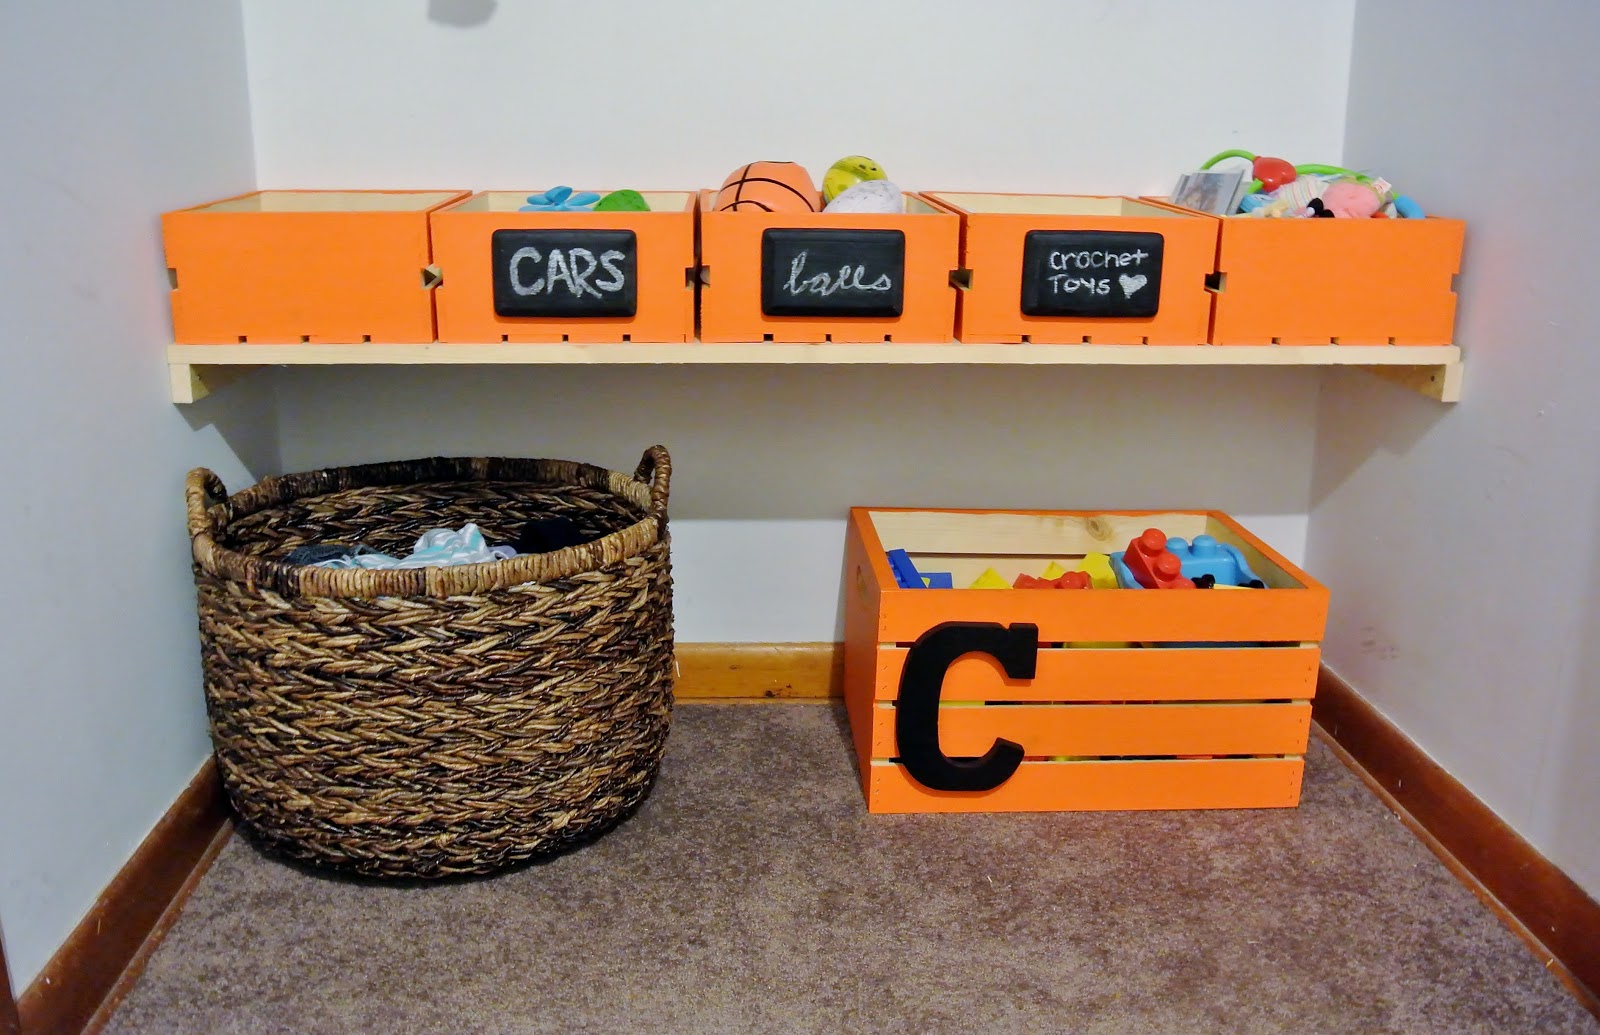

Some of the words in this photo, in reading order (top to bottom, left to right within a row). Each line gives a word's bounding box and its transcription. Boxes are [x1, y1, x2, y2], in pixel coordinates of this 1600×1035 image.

[509, 246, 626, 299] CARS
[783, 249, 892, 297] balls
[1049, 248, 1149, 271] crochet
[895, 620, 1039, 792] C
